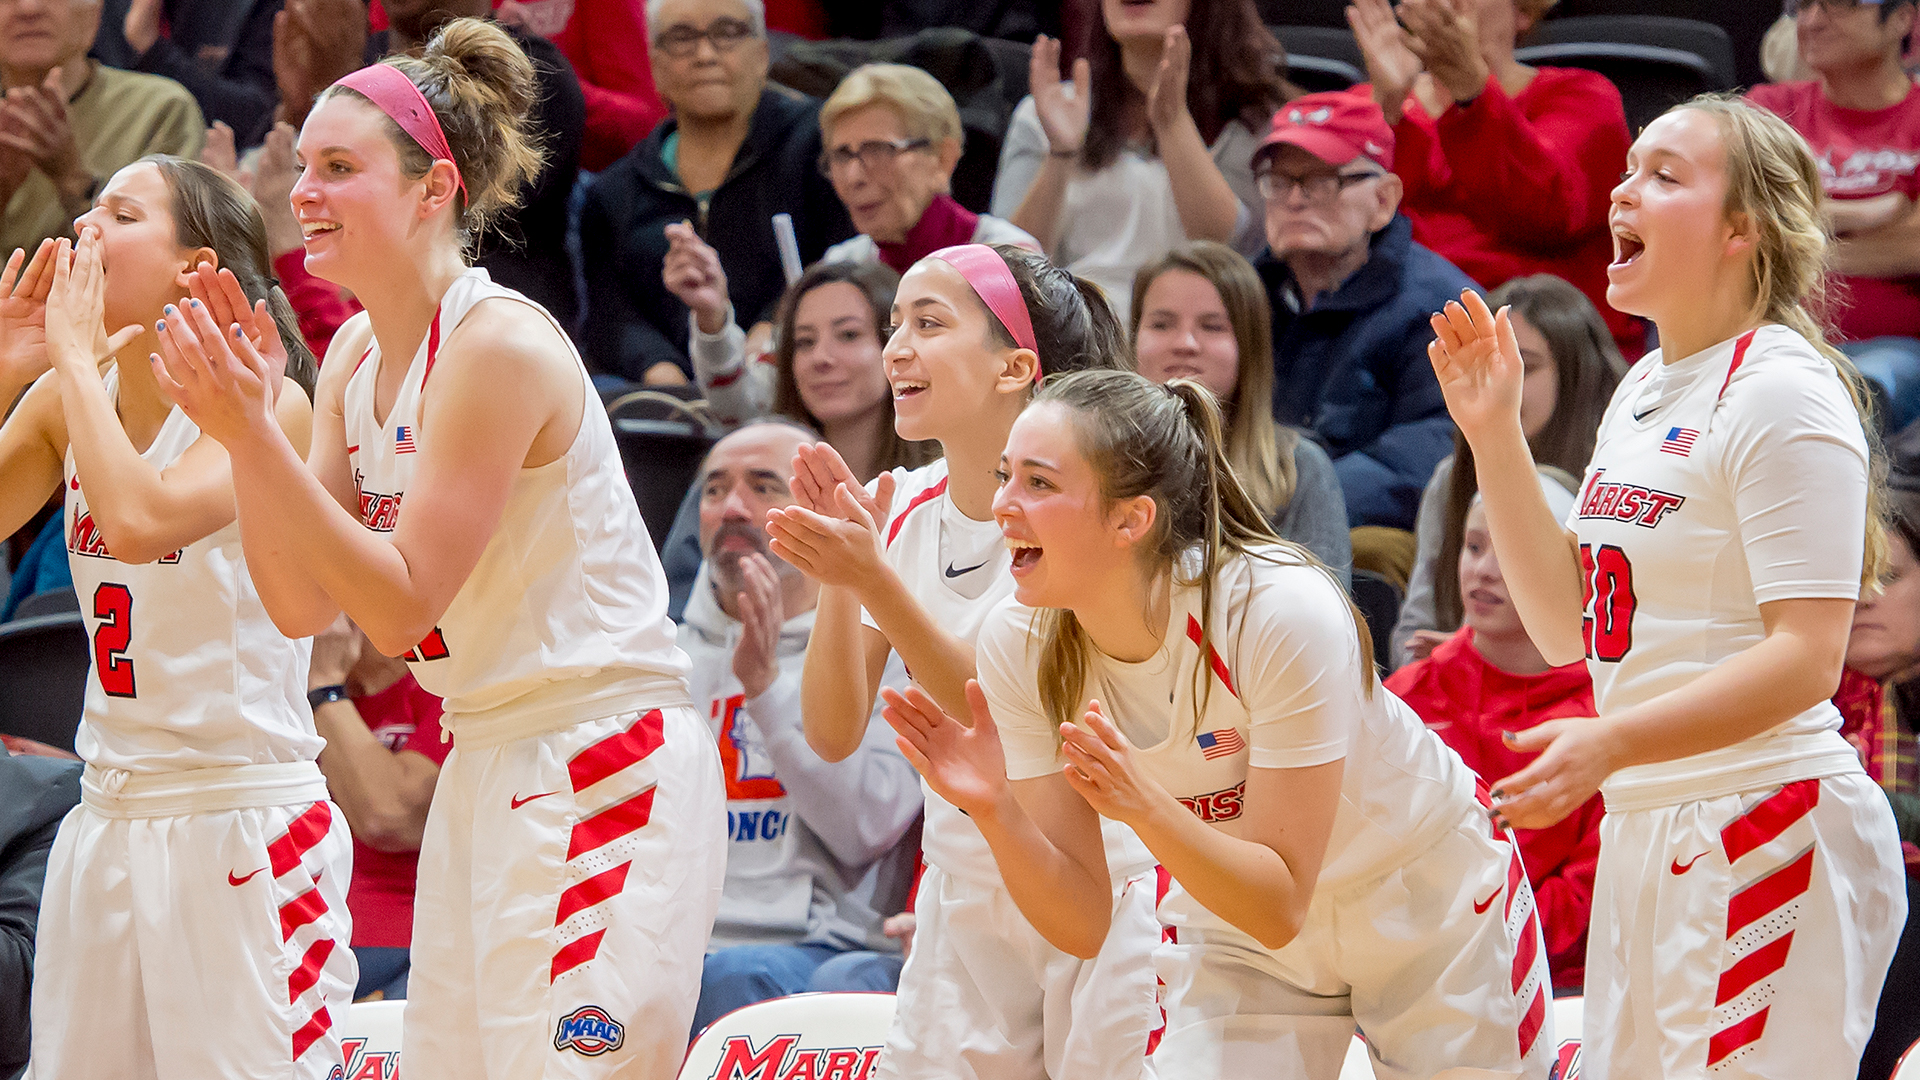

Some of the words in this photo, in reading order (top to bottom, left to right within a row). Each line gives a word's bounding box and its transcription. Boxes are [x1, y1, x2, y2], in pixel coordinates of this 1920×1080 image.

[93, 581, 137, 699] 2
[558, 1017, 620, 1046] MAAC
[706, 1034, 884, 1080] MARI
